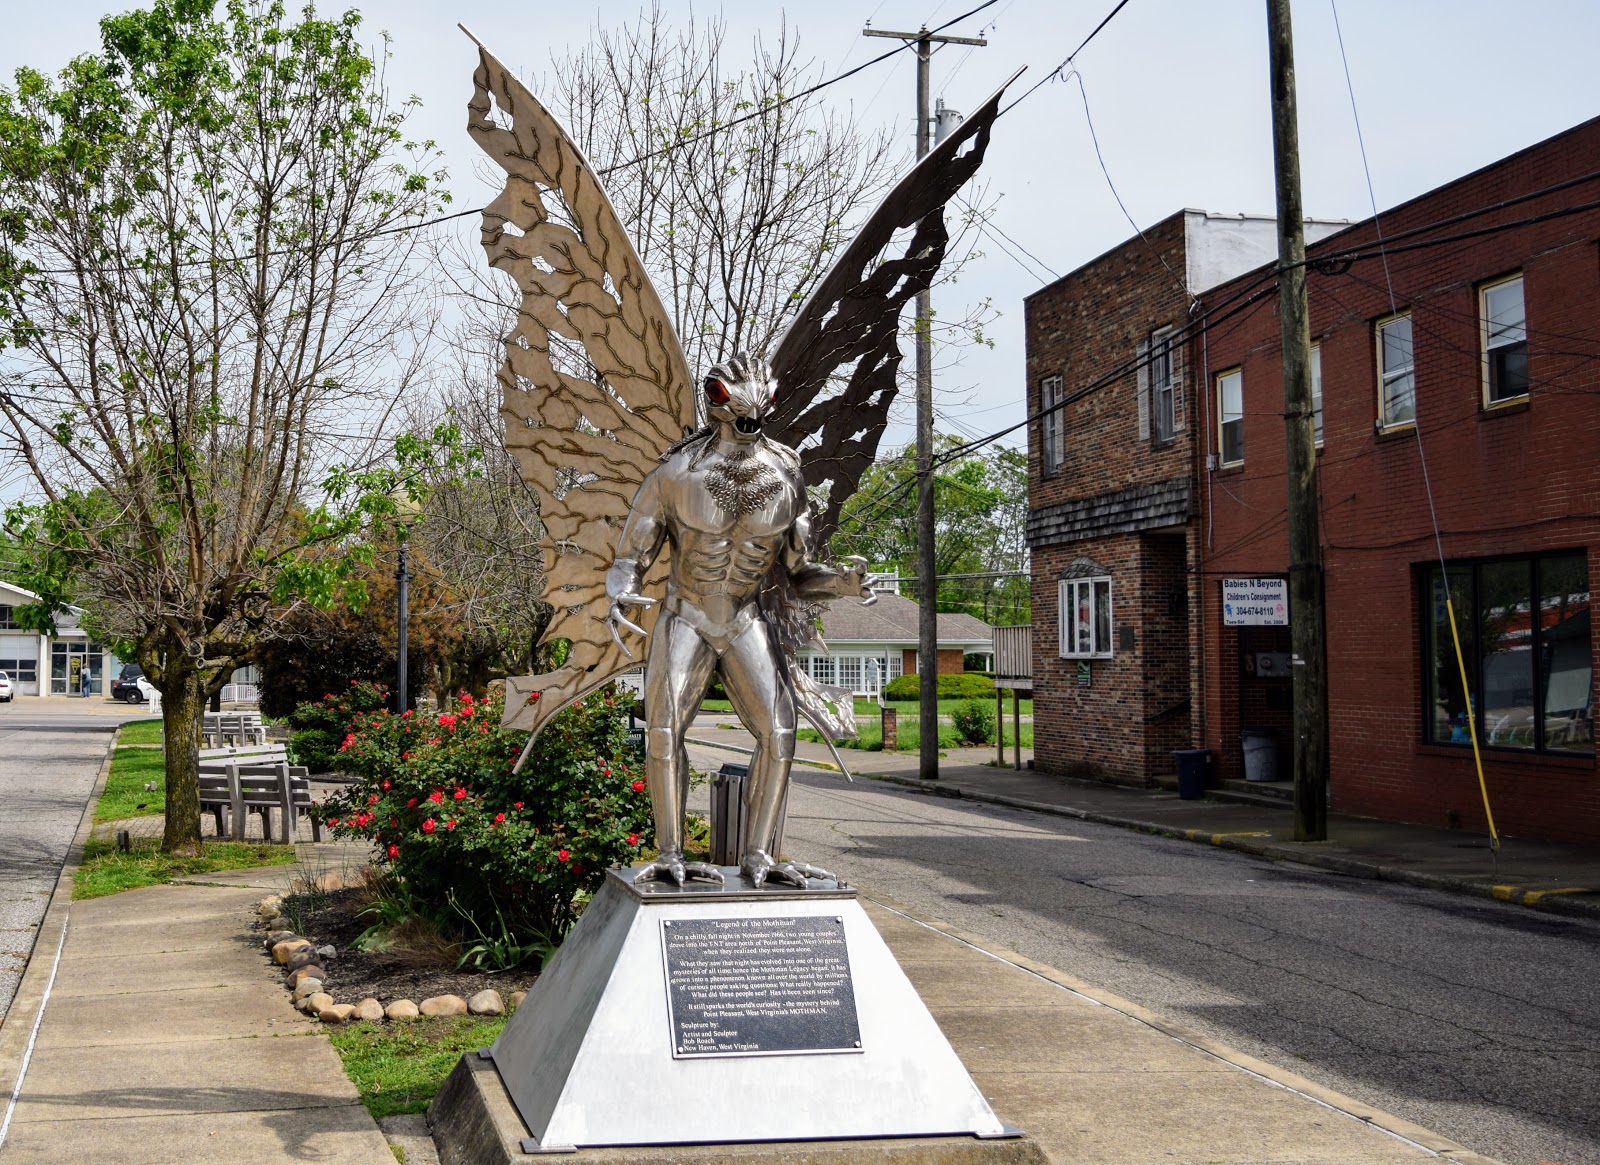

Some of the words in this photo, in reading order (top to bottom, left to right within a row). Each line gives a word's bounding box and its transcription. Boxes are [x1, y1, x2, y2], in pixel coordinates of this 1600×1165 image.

[1257, 580, 1281, 589] Beyond
[1251, 593, 1281, 602] Consignment
[1236, 607, 1273, 615] 304-674-8110
[719, 932, 733, 940] night
[720, 948, 732, 956] they
[759, 946, 769, 954] they
[697, 960, 708, 968] they
[735, 959, 749, 967] night
[825, 956, 839, 964] great
[674, 968, 700, 976] mysteries
[790, 965, 808, 973] Legacy
[710, 982, 728, 990] people
[730, 982, 748, 990] asking
[796, 980, 811, 988] really
[736, 990, 753, 998] people
[706, 1002, 724, 1011] sparks
[756, 1001, 780, 1009] curiosity
[796, 1000, 818, 1008] mystery
[681, 1022, 708, 1030] Sculpture
[713, 1030, 737, 1038] Sculptor
[734, 1042, 758, 1051] Virginia
